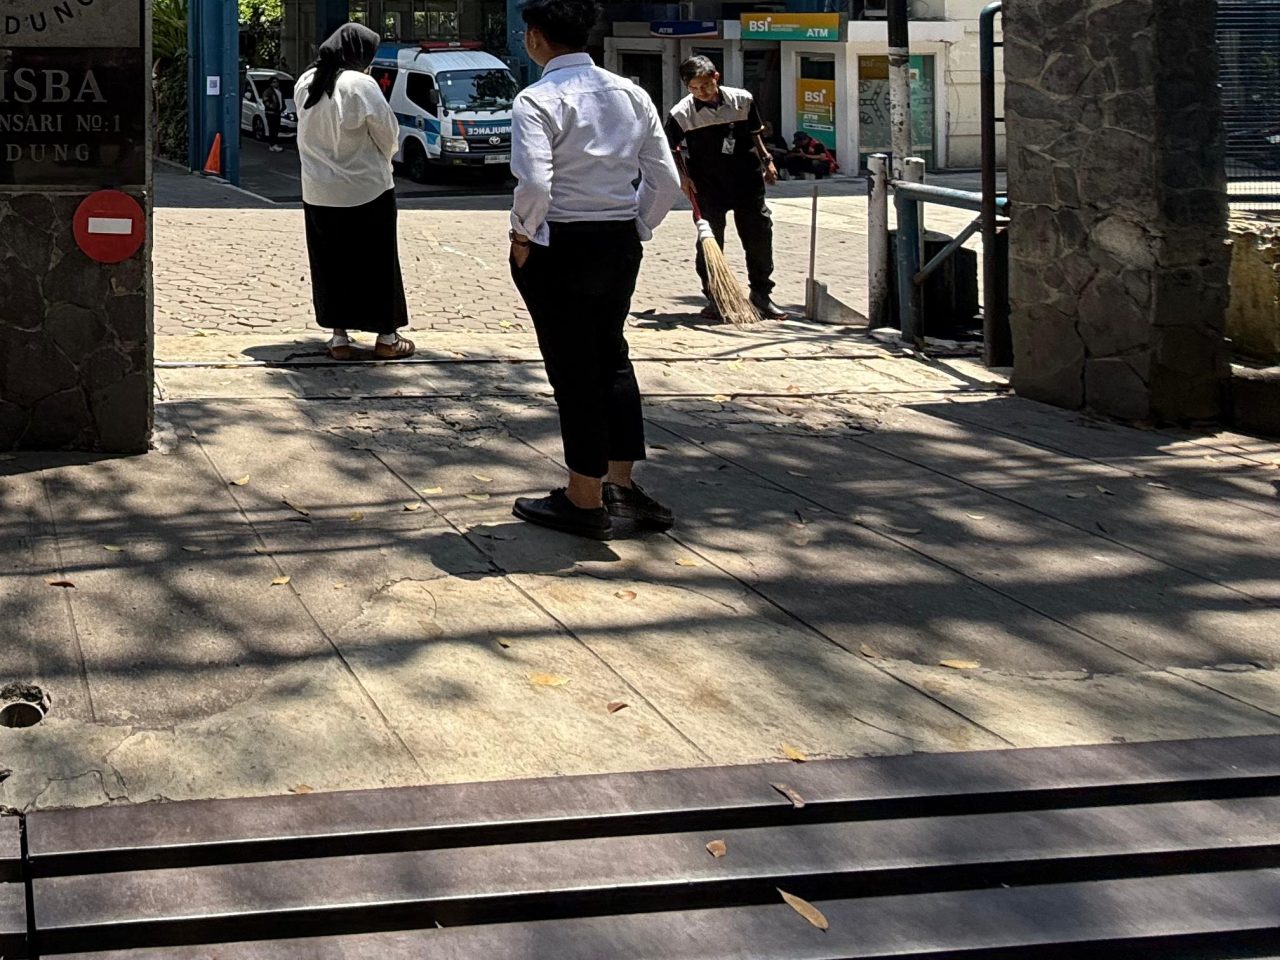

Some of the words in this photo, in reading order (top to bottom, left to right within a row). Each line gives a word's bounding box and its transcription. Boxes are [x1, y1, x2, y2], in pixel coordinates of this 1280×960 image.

[749, 18, 770, 32] BSI
[806, 28, 829, 38] ATM
[804, 90, 825, 103] BSI
